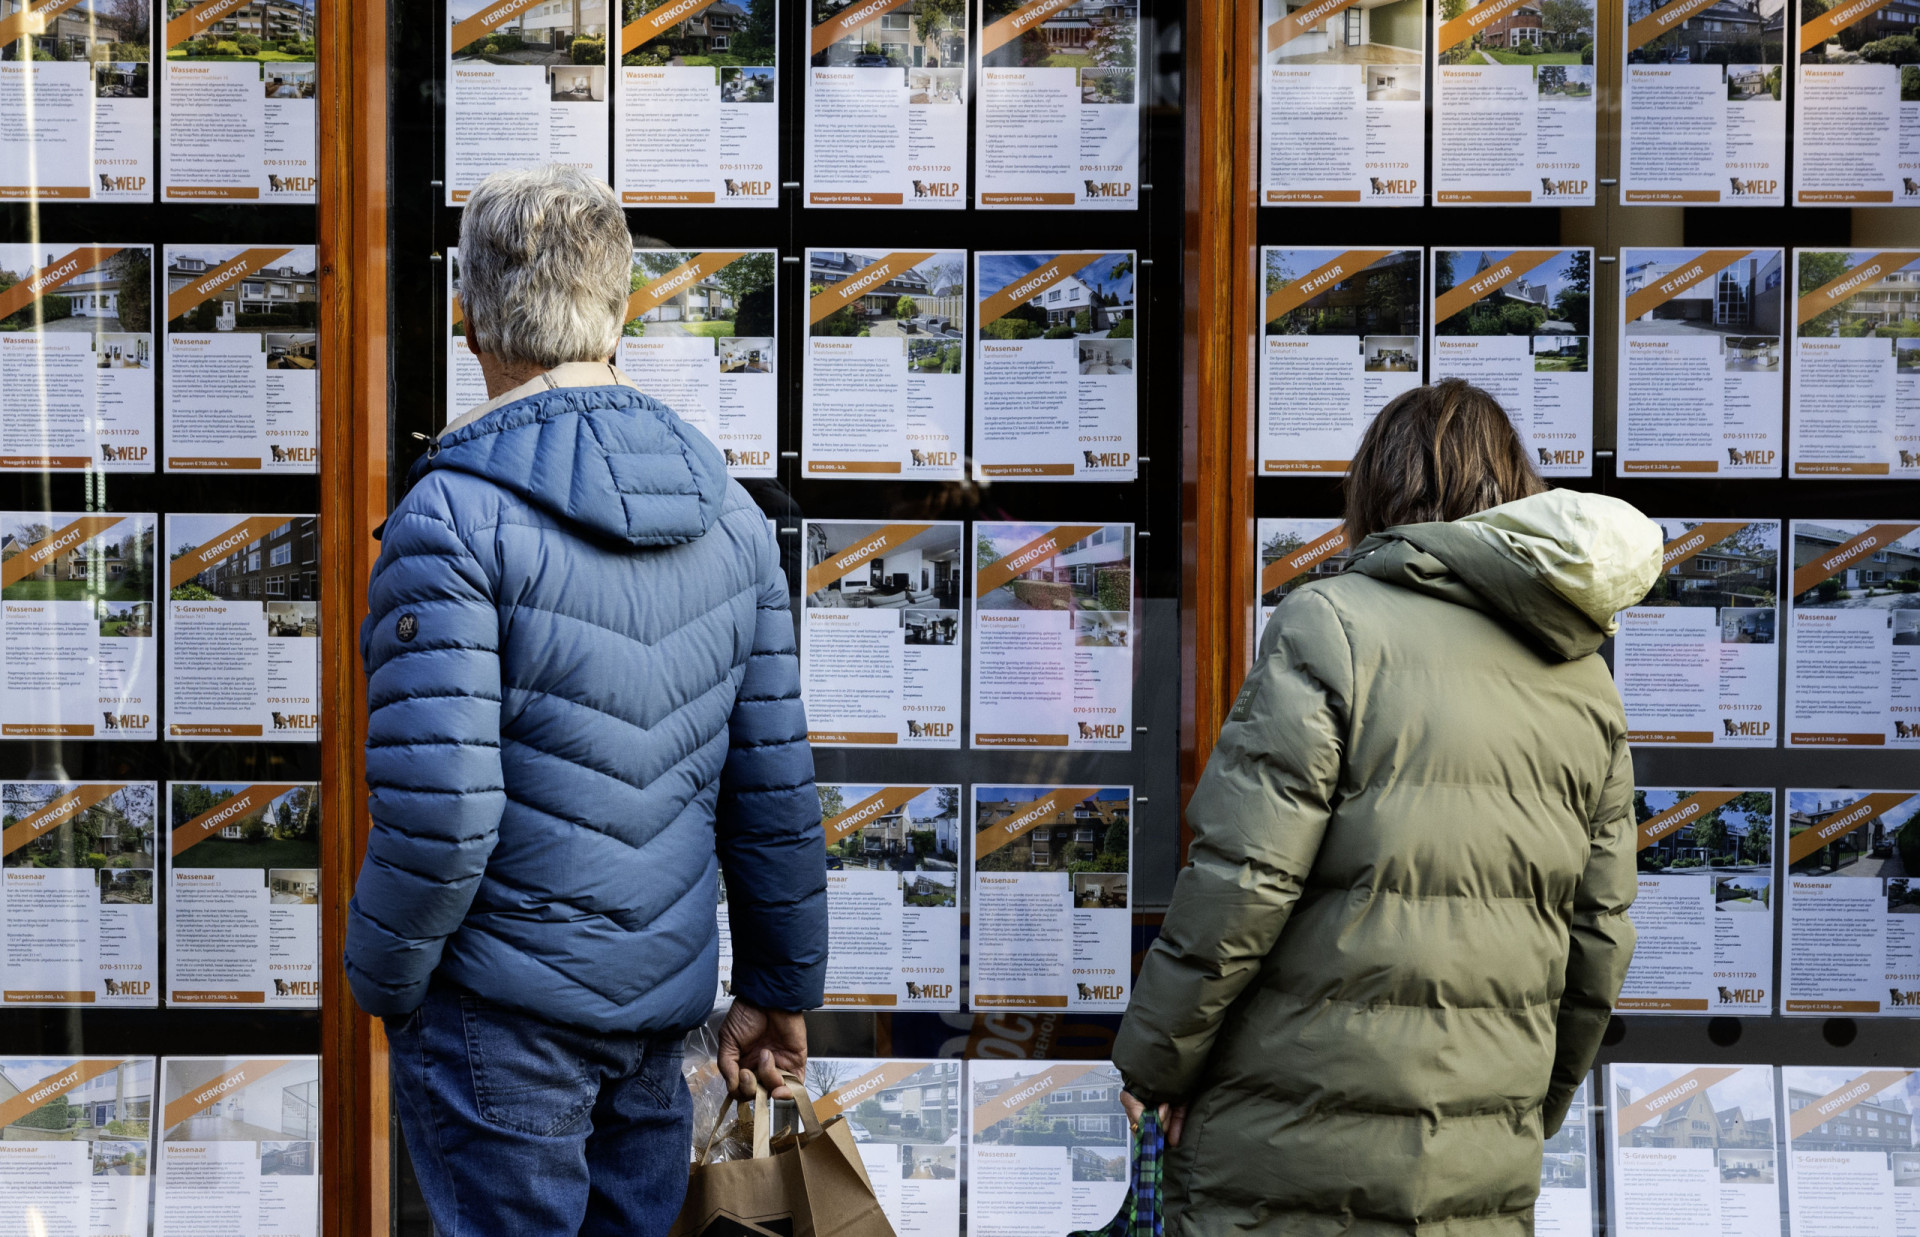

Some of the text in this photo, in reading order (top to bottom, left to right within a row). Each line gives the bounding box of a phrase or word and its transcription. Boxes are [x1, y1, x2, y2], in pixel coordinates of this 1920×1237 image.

[815, 72, 855, 80] Wassenaar
[986, 72, 1025, 80] Wassenaar
[1804, 69, 1844, 77] Wassenaar
[115, 176, 146, 191] WELP
[741, 181, 771, 196] WELP
[929, 183, 959, 197] WELP
[1101, 183, 1131, 197] WELP
[1387, 180, 1417, 194] WELP
[1558, 181, 1588, 195] WELP
[1747, 180, 1777, 194] WELP
[28, 259, 78, 294] VERKOCHT
[197, 260, 248, 294] VERKOCHT
[650, 264, 701, 299] VERKOCHT
[839, 264, 890, 299] VERKOCHT
[1008, 266, 1060, 301] VERKOCHT
[1300, 266, 1343, 294] TE HUUR
[1469, 266, 1512, 294] TE HUUR
[1660, 266, 1704, 294] TE HUUR
[1827, 264, 1881, 300] VERHUURD
[813, 341, 852, 349] Wassenaar
[1801, 342, 1841, 350] Wassenaar
[1532, 432, 1576, 440] 070-5111720
[1723, 432, 1767, 440] 070-5111720
[117, 446, 148, 460] WELP
[740, 452, 770, 466] WELP
[927, 452, 957, 467] WELP
[1100, 453, 1130, 467] WELP
[1554, 450, 1584, 464] WELP
[1744, 450, 1775, 464] WELP
[30, 528, 81, 562] VERKOCHT
[199, 528, 250, 563] VERKOCHT
[1290, 535, 1344, 569] VERHUURD
[1661, 534, 1705, 566] ERHUURD
[836, 536, 888, 570] VERKOCHT
[1006, 538, 1058, 572] VERKOCHT
[1822, 536, 1877, 571] VERHUURD
[1626, 611, 1665, 619] Wassenaar
[902, 704, 946, 712] 070-5111720
[119, 714, 149, 728] WELP
[1740, 722, 1770, 735] WELP
[924, 723, 954, 737] WELP
[1094, 725, 1125, 739] WELP
[32, 796, 81, 830] VERKOCHT
[201, 796, 251, 830] VERKOCHT
[834, 799, 886, 833] VERKOCHT
[1005, 800, 1056, 834] VERKOCHT
[1646, 803, 1700, 838] VERHUURD
[1818, 805, 1872, 840] VERHUURD
[979, 876, 1019, 884] Wassenaar
[120, 981, 150, 995] WELP
[922, 985, 952, 999] WELP
[1093, 986, 1123, 1000] WELP
[1734, 990, 1764, 1003] WELP
[27, 1071, 79, 1104] VERKOCHT
[195, 1071, 246, 1105] VERKOCHT
[833, 1073, 886, 1107] VERKOCHT
[1002, 1076, 1054, 1109] VERKOCHT
[1645, 1079, 1698, 1112] VERHUURD
[1818, 1082, 1870, 1115] VERHUURD
